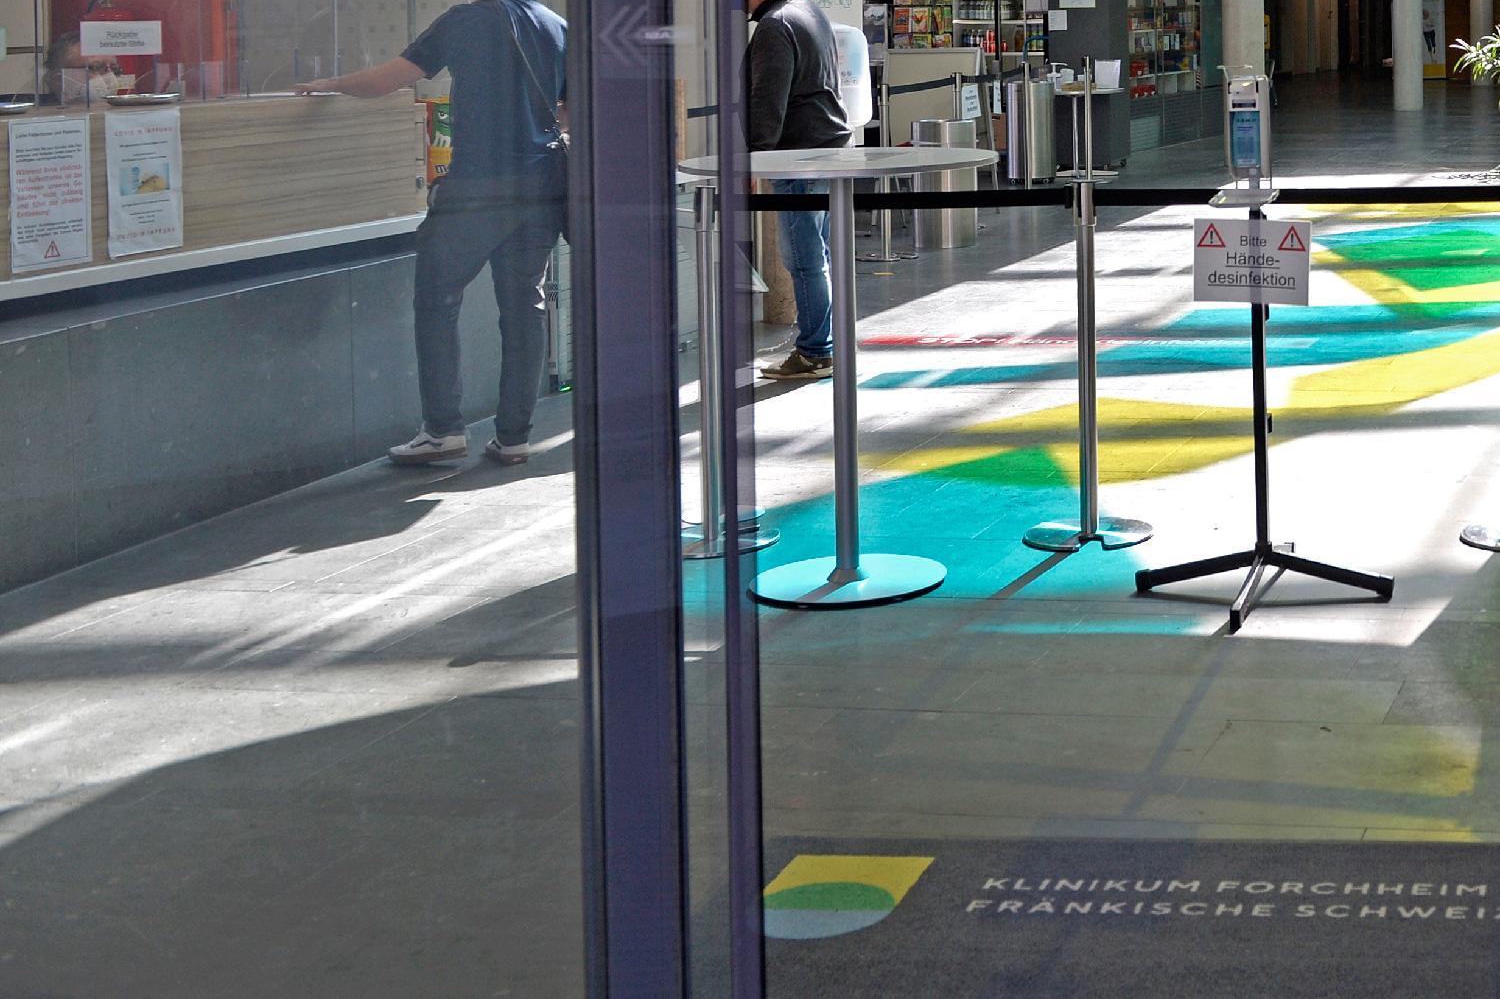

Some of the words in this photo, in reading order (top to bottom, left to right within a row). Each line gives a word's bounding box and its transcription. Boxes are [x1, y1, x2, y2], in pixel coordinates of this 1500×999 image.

[1239, 235, 1267, 247] Bitte
[1226, 251, 1280, 266] Hände-
[1207, 270, 1296, 287] desinfektion
[982, 877, 1202, 894] KLINIKUM
[1215, 880, 1490, 897] FORCHHEIM
[965, 897, 1275, 918] FRÄNKISCHE
